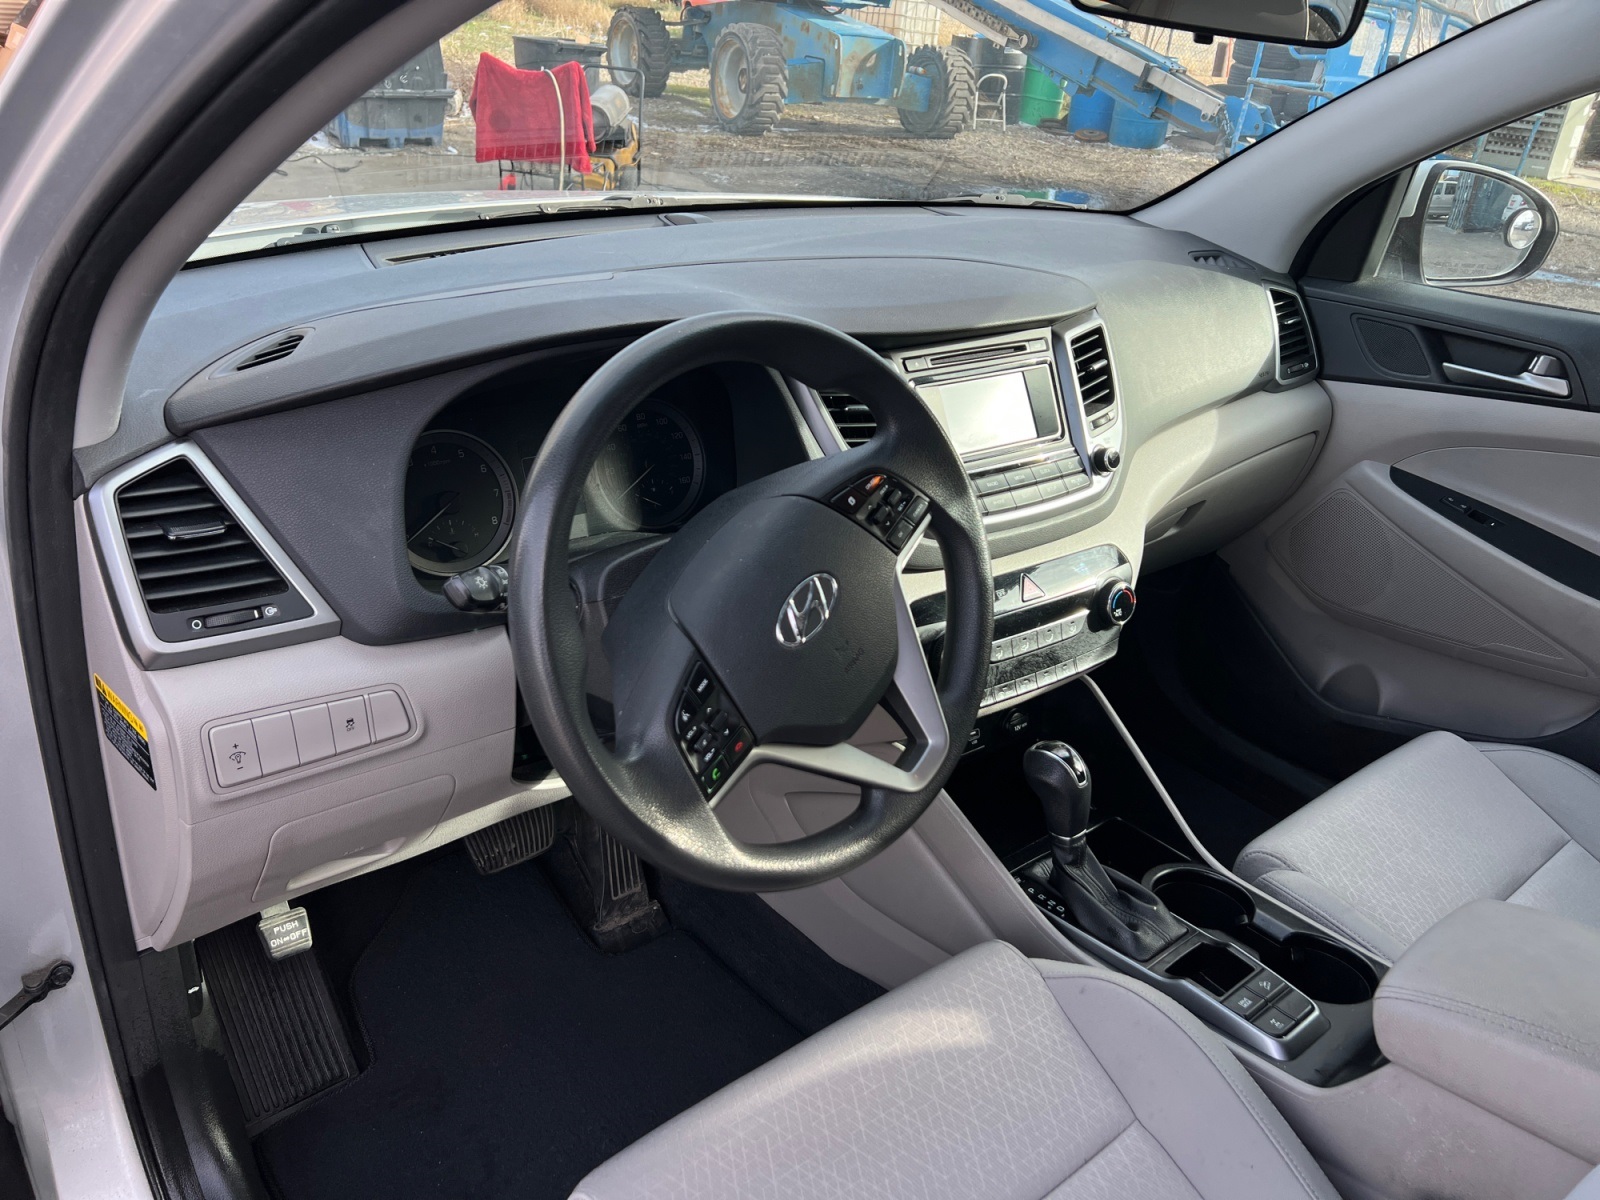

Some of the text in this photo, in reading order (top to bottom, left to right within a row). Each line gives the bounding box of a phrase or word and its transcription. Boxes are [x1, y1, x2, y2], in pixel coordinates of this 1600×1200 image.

[656, 418, 668, 426] 100
[671, 432, 684, 440] 120
[431, 445, 437, 454] 4
[458, 449, 465, 458] 5
[480, 464, 487, 473] 6
[493, 489, 499, 497] 7
[491, 516, 498, 525] 8
[273, 920, 299, 935] PUSH
